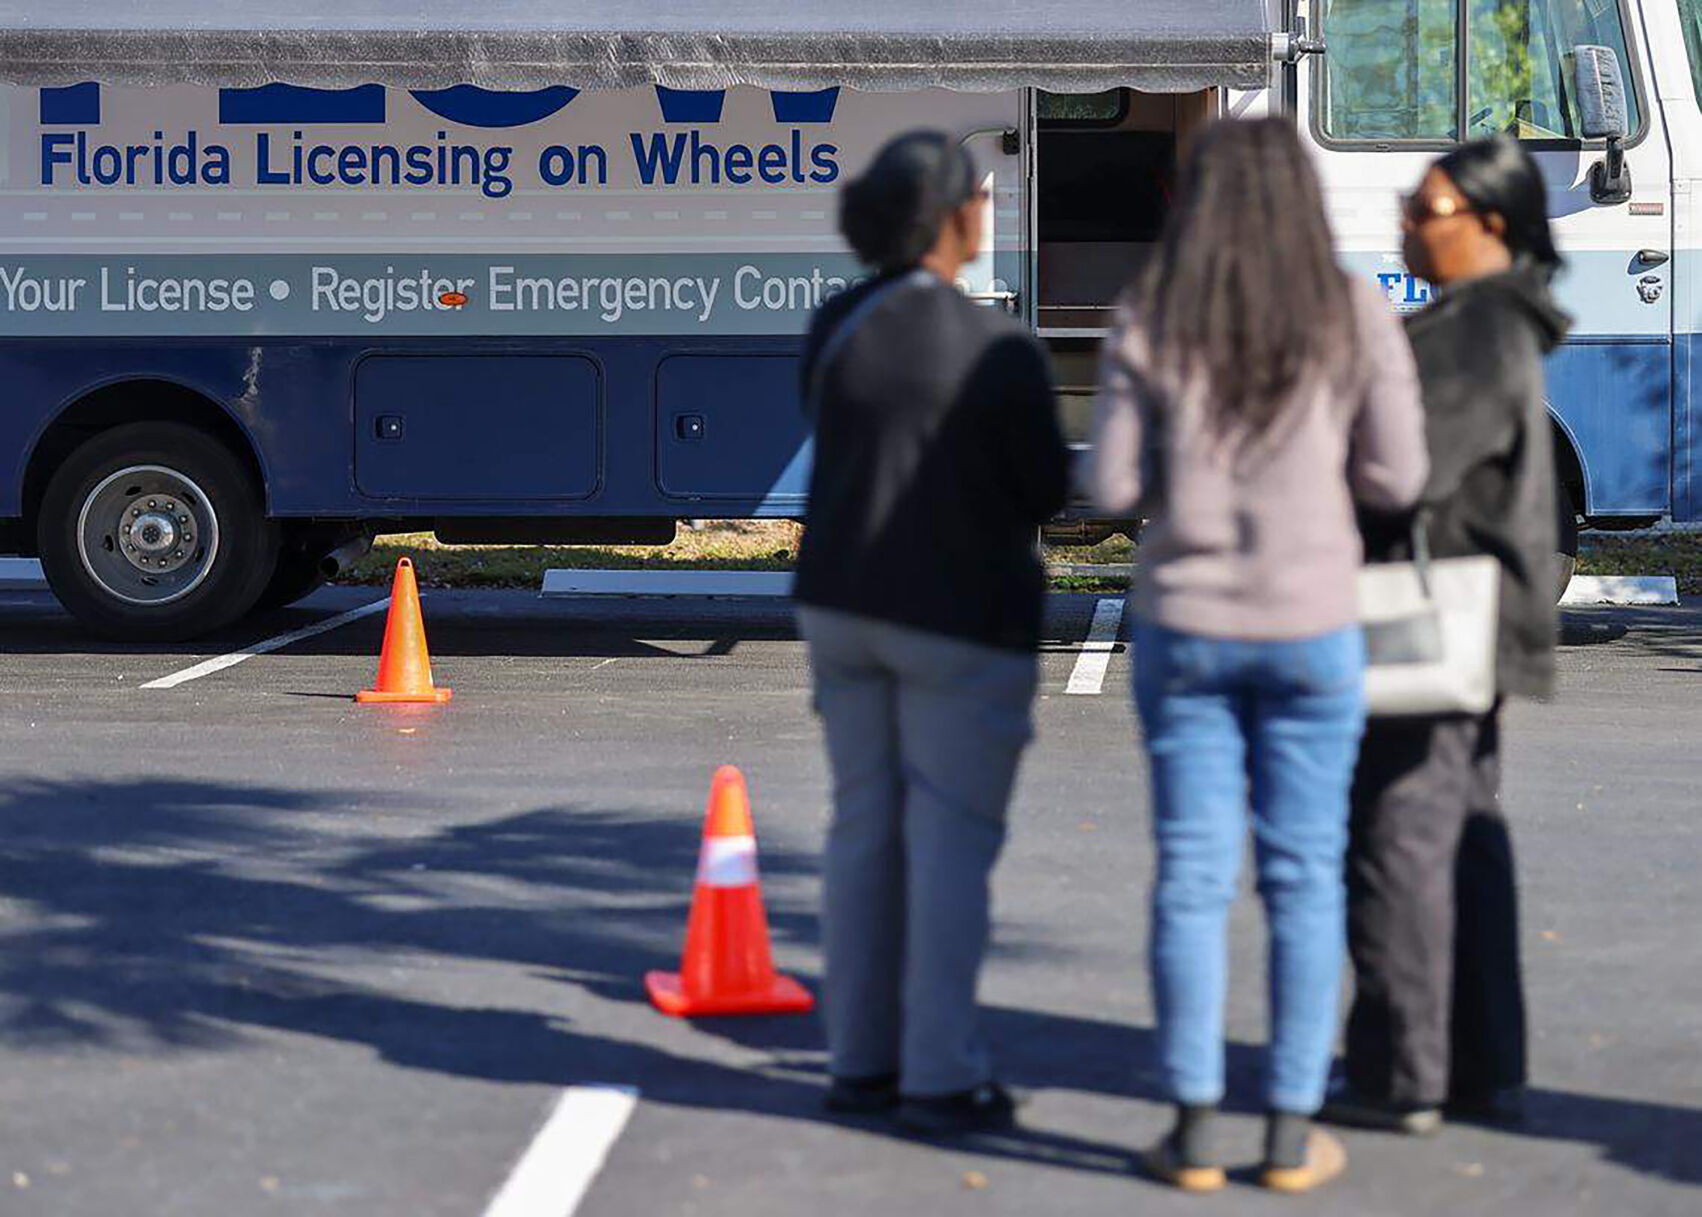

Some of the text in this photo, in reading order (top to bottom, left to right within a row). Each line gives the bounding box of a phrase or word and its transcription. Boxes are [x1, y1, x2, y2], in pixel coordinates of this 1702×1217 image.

[41, 130, 839, 198] Florida Licensing on Wheels
[0, 265, 869, 323] Your License Register Emergency Conta
